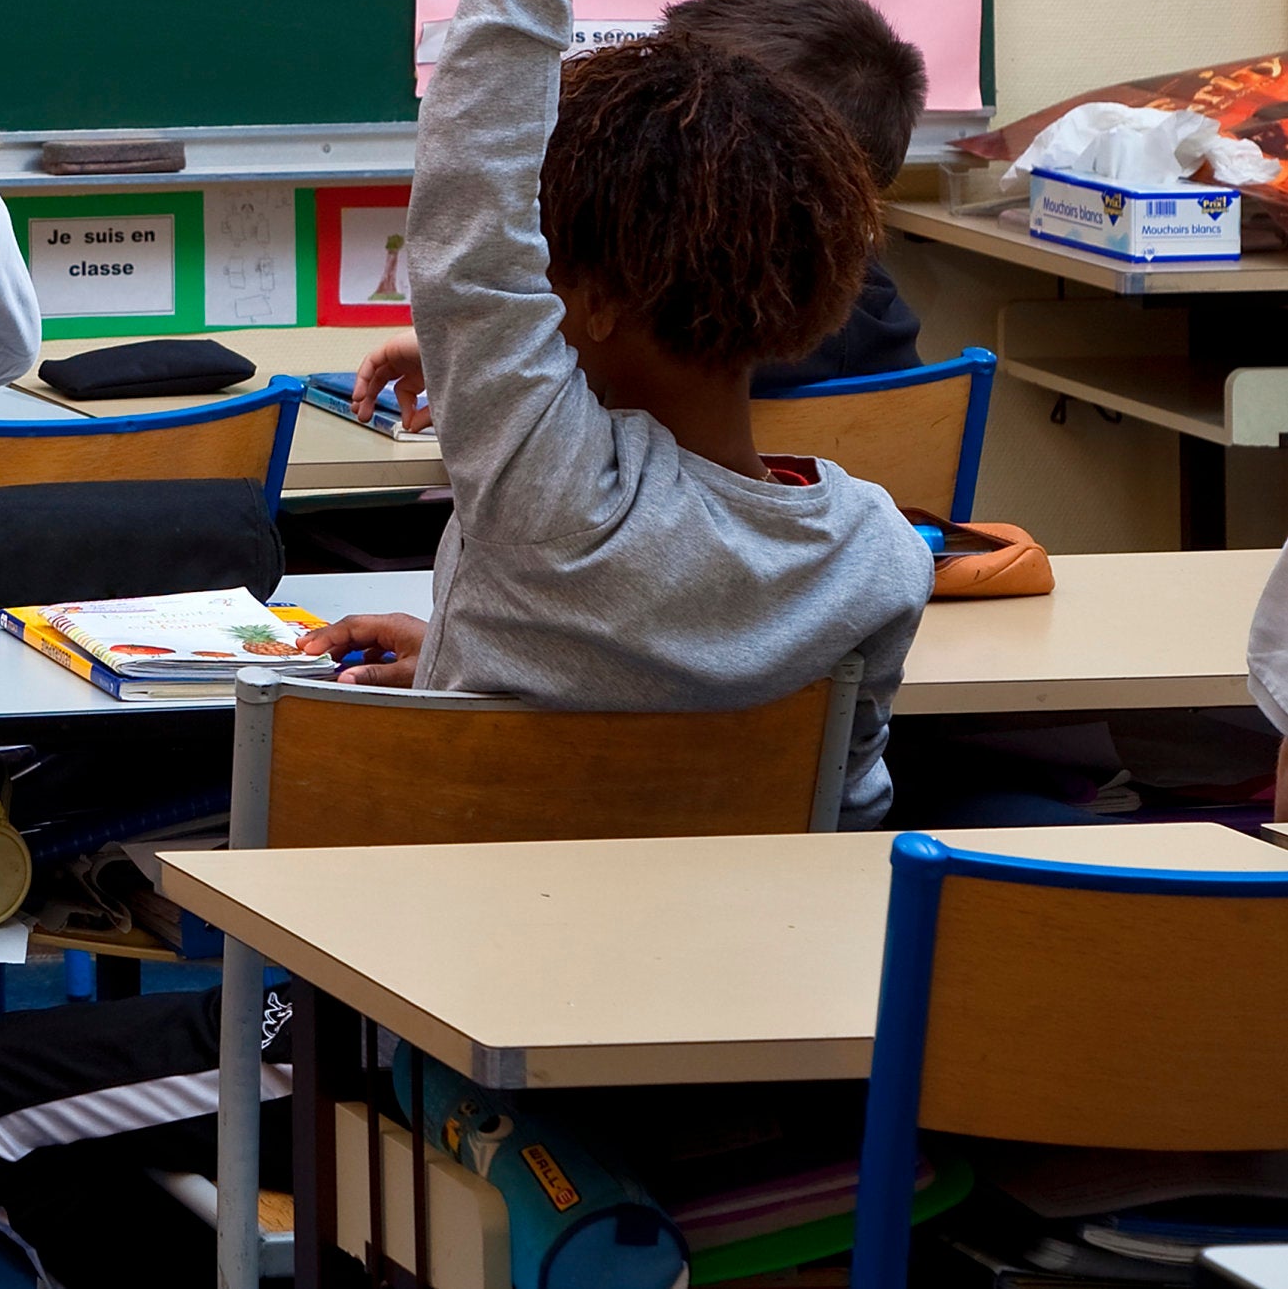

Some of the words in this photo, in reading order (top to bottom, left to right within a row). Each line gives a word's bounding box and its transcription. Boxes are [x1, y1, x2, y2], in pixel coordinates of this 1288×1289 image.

[1043, 197, 1079, 219] Mouchoirs
[1079, 205, 1103, 225] blancs
[1141, 224, 1190, 234] Mouchoirs
[1191, 223, 1222, 234] blancs
[48, 229, 71, 246] Je
[84, 229, 124, 244] suis
[131, 229, 156, 243] en
[68, 260, 134, 277] classe
